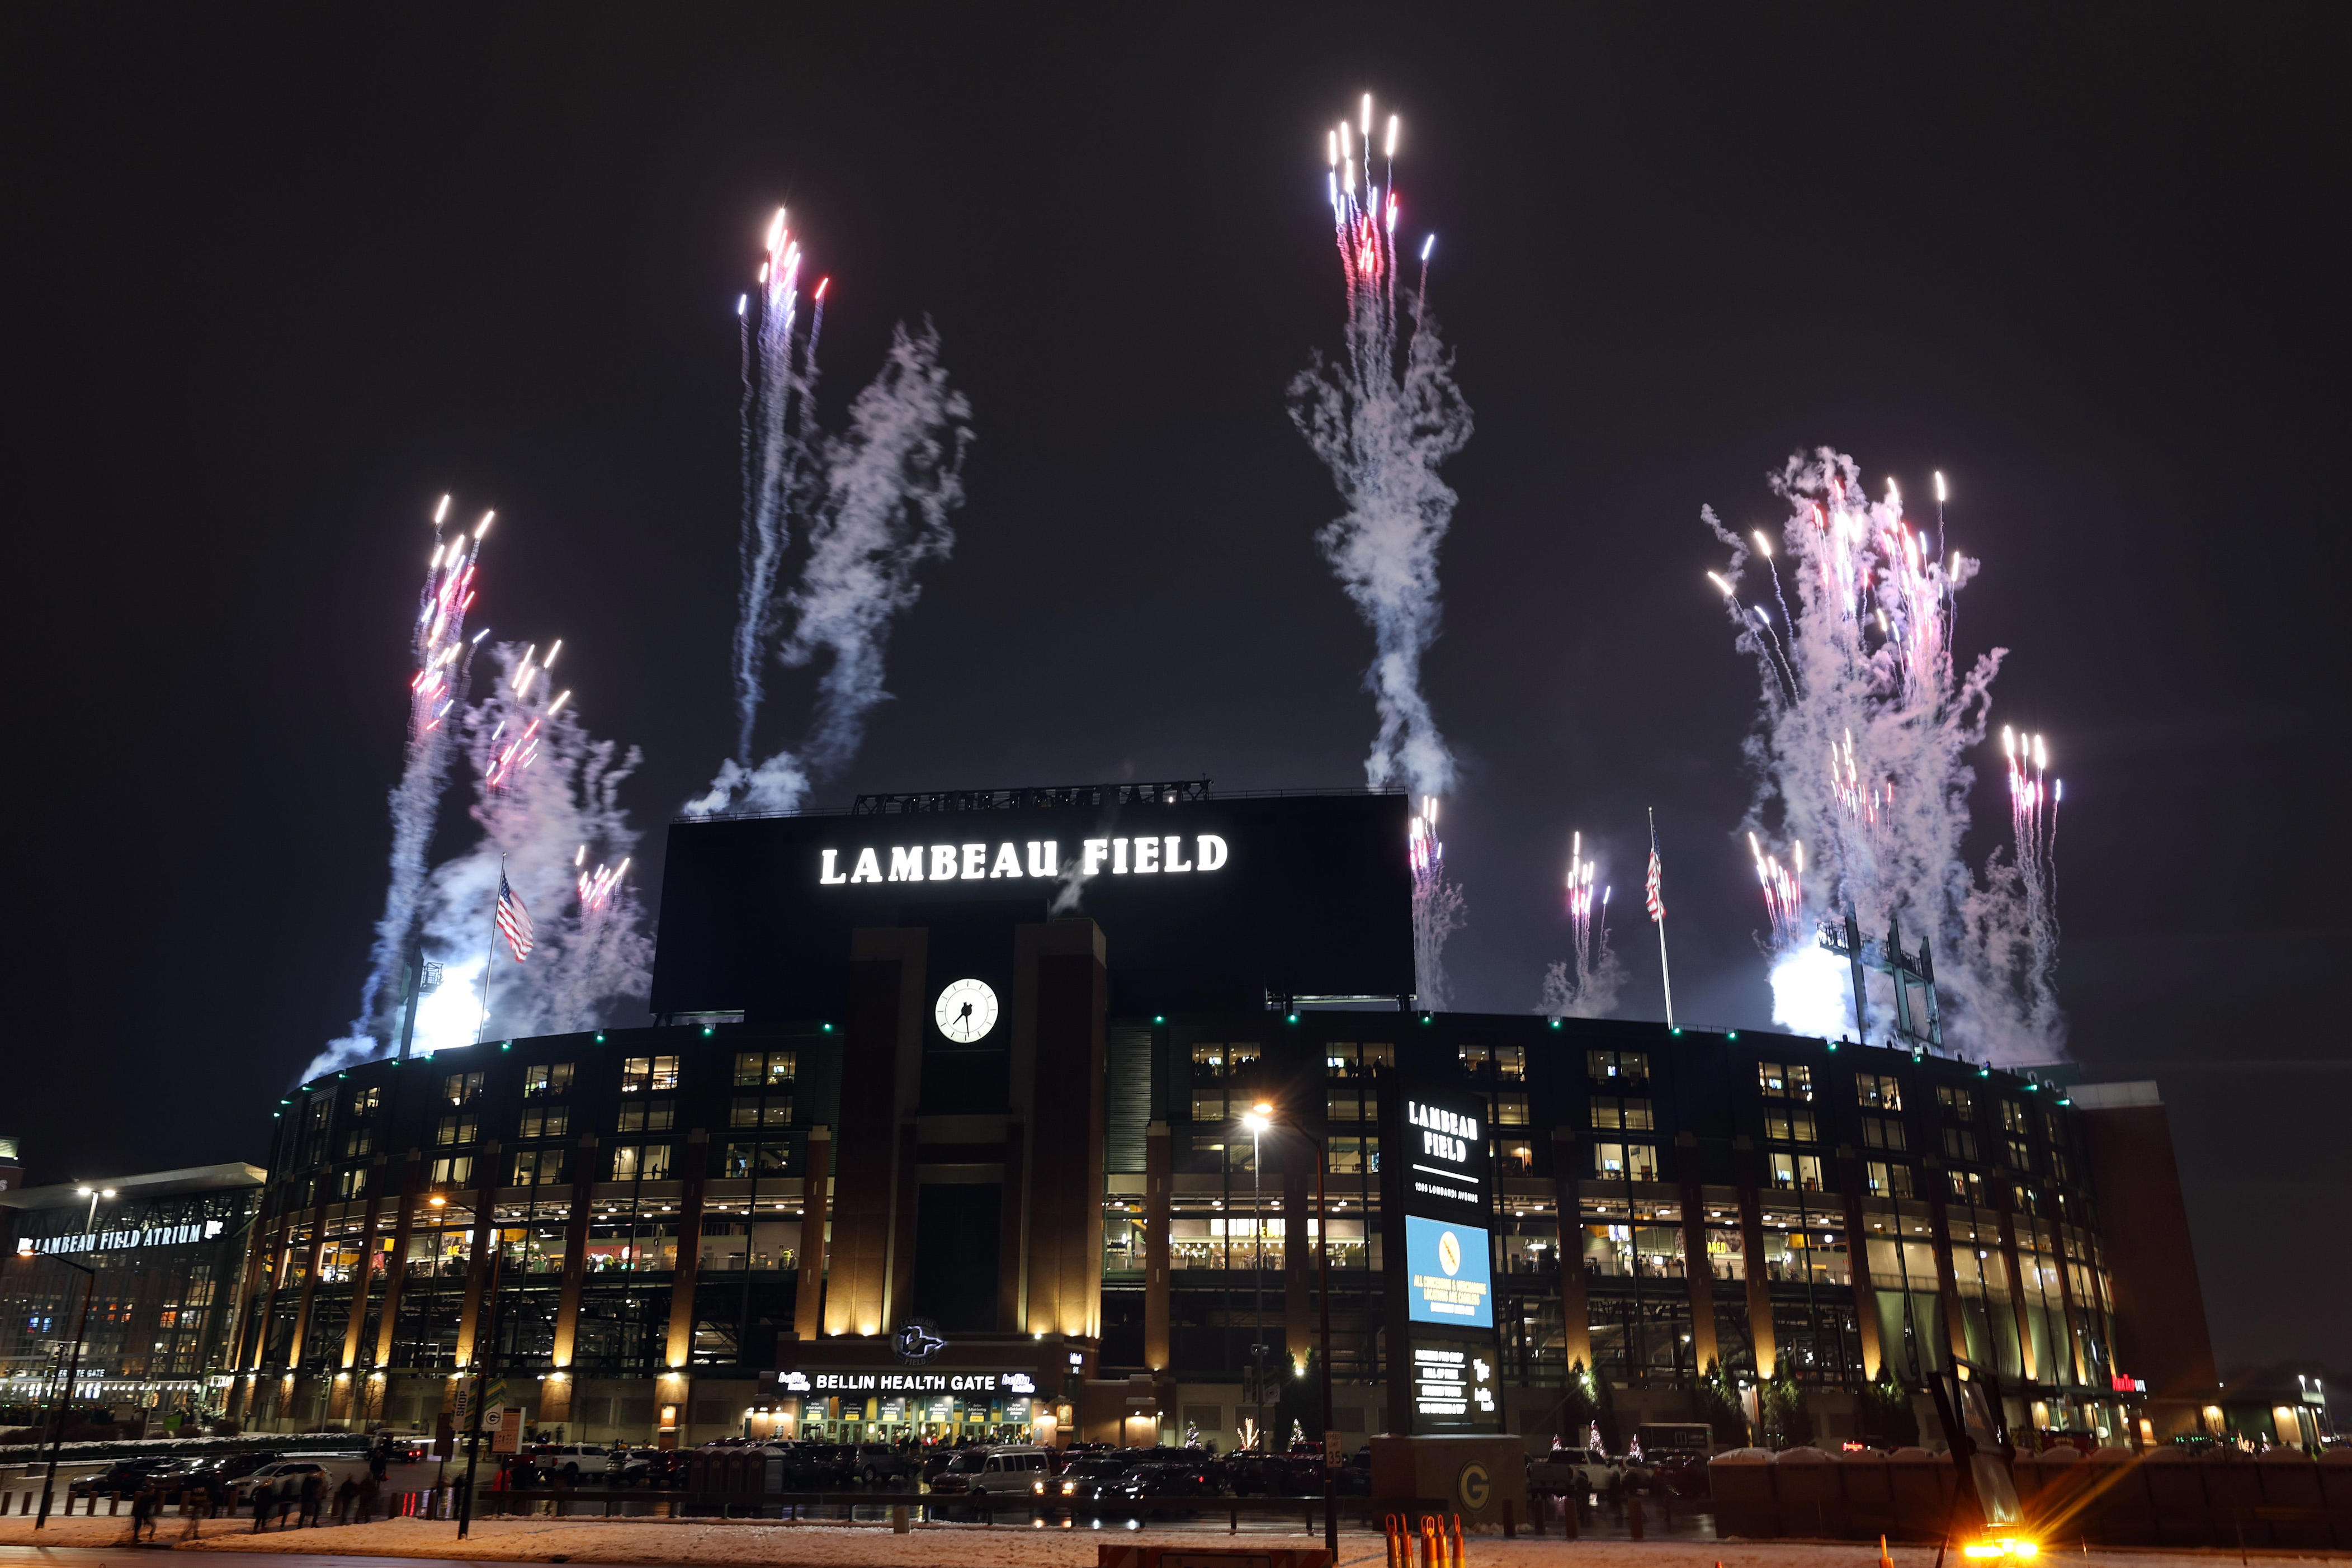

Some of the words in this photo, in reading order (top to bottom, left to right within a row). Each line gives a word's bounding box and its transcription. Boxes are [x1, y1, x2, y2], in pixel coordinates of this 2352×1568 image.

[819, 840, 1059, 885] LAMBEAU
[1081, 834, 1229, 877] FIELD
[1408, 1101, 1478, 1141] LAMBEAU
[1423, 1131, 1466, 1163] FIELD
[1429, 1184, 1457, 1199] LOMBARDI
[1458, 1191, 1479, 1203] AVENUE
[34, 1234, 96, 1255] LAMBEAU
[100, 1230, 140, 1250] FIELD
[143, 1224, 202, 1246] ATRIUM
[86, 1368, 105, 1378] GATE
[816, 1374, 875, 1390] BELLIN
[880, 1375, 946, 1390] HEALTH
[951, 1375, 995, 1391] GATE
[456, 1390, 467, 1416] SHOP
[1329, 1451, 1341, 1464] 35
[1460, 1464, 1491, 1510] G
